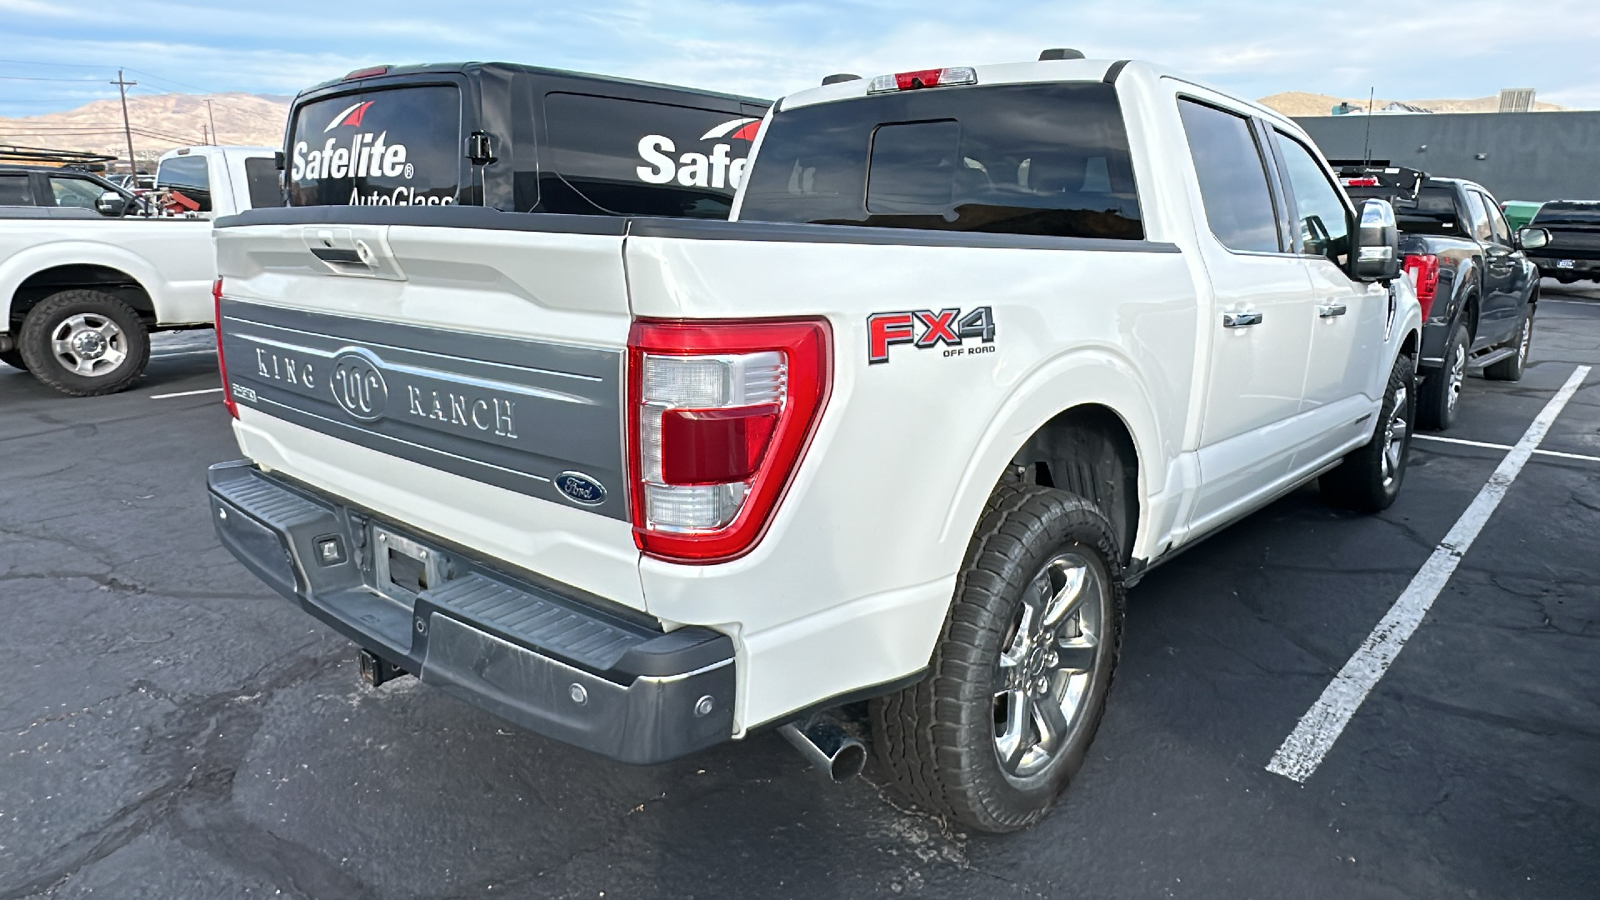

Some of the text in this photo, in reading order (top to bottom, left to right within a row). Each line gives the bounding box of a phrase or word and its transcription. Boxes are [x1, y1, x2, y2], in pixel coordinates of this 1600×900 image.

[866, 306, 996, 366] FX4
[943, 345, 996, 357] OFF ROAD
[256, 347, 315, 388] KING
[407, 385, 518, 438] RANCH
[565, 476, 593, 499] Ford
